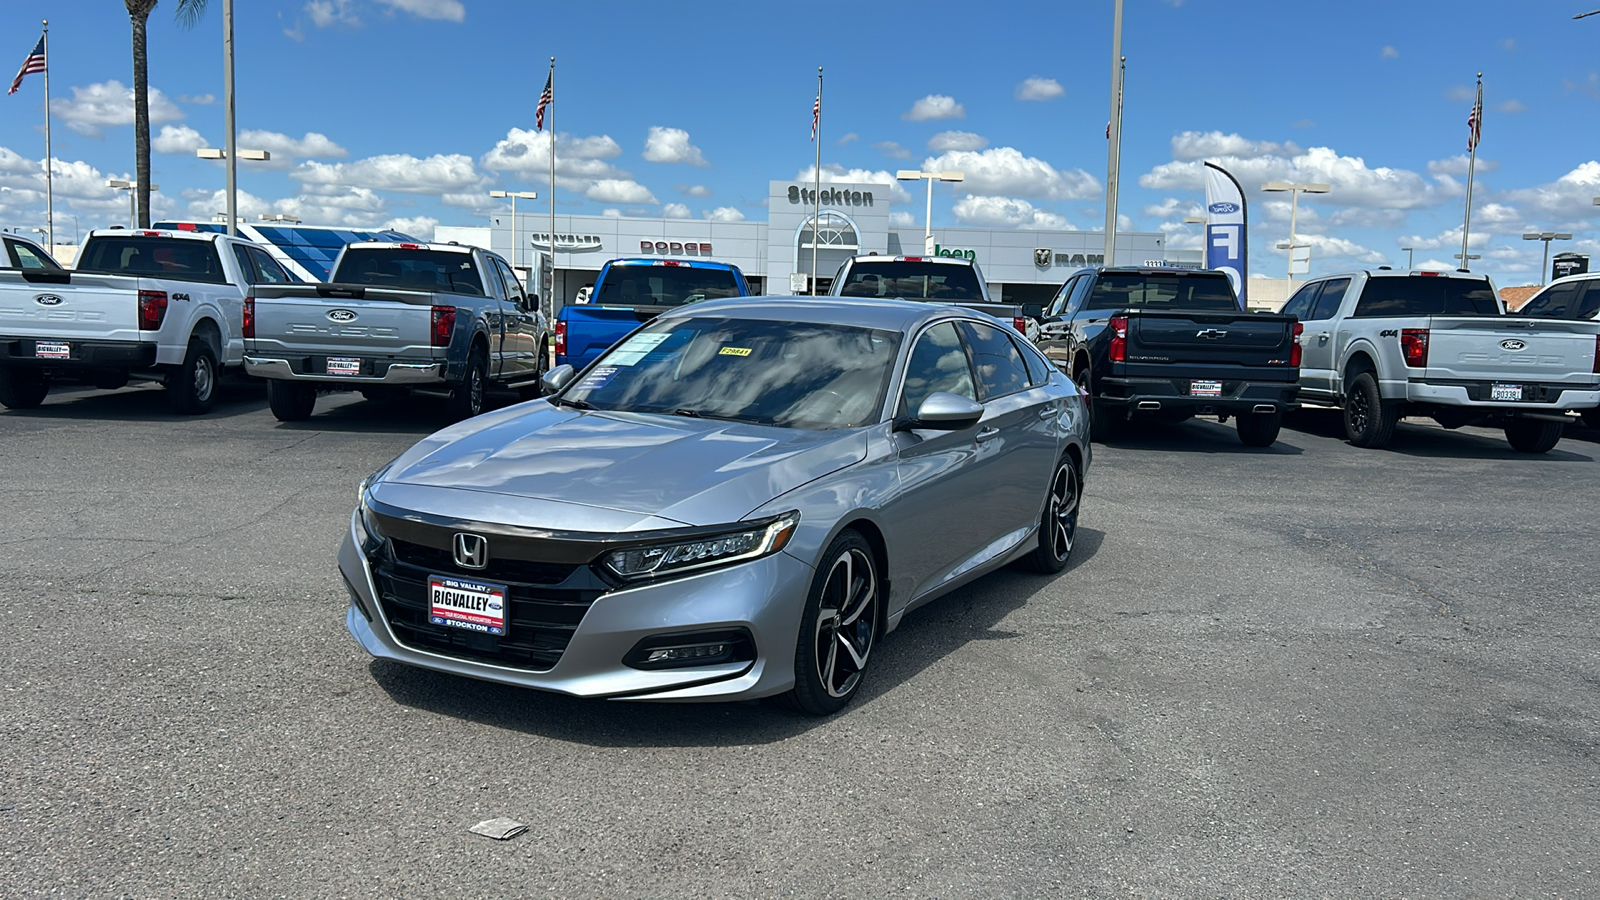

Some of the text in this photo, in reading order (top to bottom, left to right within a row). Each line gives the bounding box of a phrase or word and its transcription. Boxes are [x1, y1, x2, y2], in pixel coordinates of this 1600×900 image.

[788, 185, 873, 203] Stockton
[641, 241, 712, 252] DODGE
[1055, 253, 1105, 264] RAM
[38, 294, 61, 304] Ford
[331, 311, 353, 321] Ford
[286, 322, 399, 339] F-150
[1502, 340, 1524, 350] Ford
[1458, 353, 1565, 366] F-150
[460, 582, 487, 592] VALLEY
[433, 590, 489, 612] BIGVALLEY
[446, 619, 488, 632] STOCKTON
